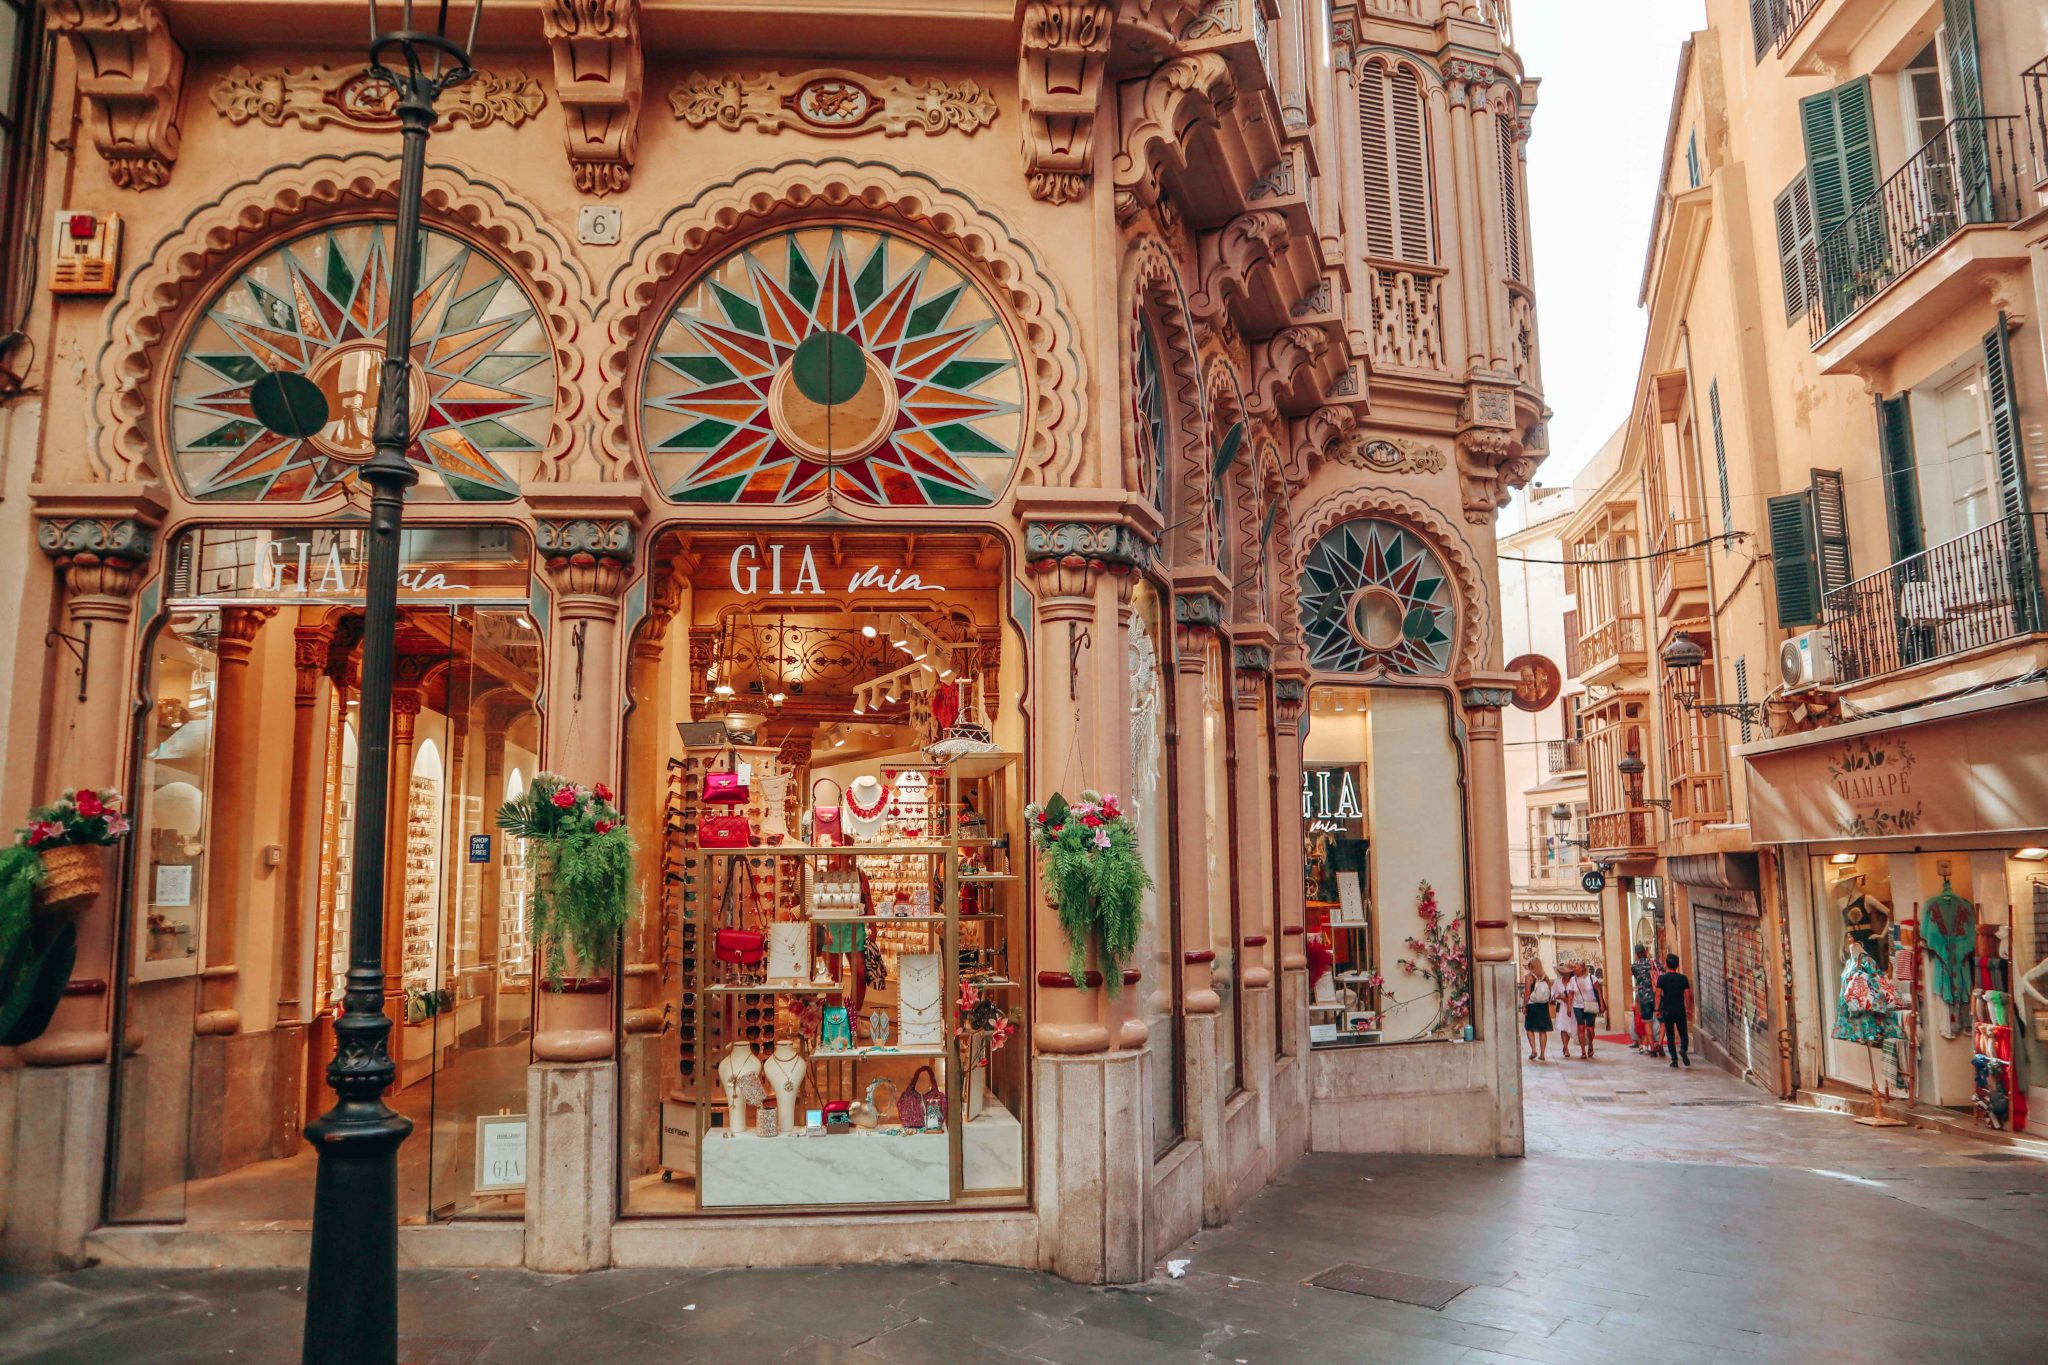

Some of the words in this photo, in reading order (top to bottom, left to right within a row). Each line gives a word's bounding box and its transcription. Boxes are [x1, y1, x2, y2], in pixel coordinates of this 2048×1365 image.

[593, 215, 606, 234] 6
[255, 541, 349, 593] GIA
[729, 544, 825, 595] GIA
[847, 565, 946, 593] mia
[1585, 878, 1602, 887] GIA
[1643, 879, 1658, 899] GIA
[1521, 902, 1540, 912] LAS
[1546, 902, 1599, 913] COLUMNAS
[492, 1159, 520, 1177] GIA
